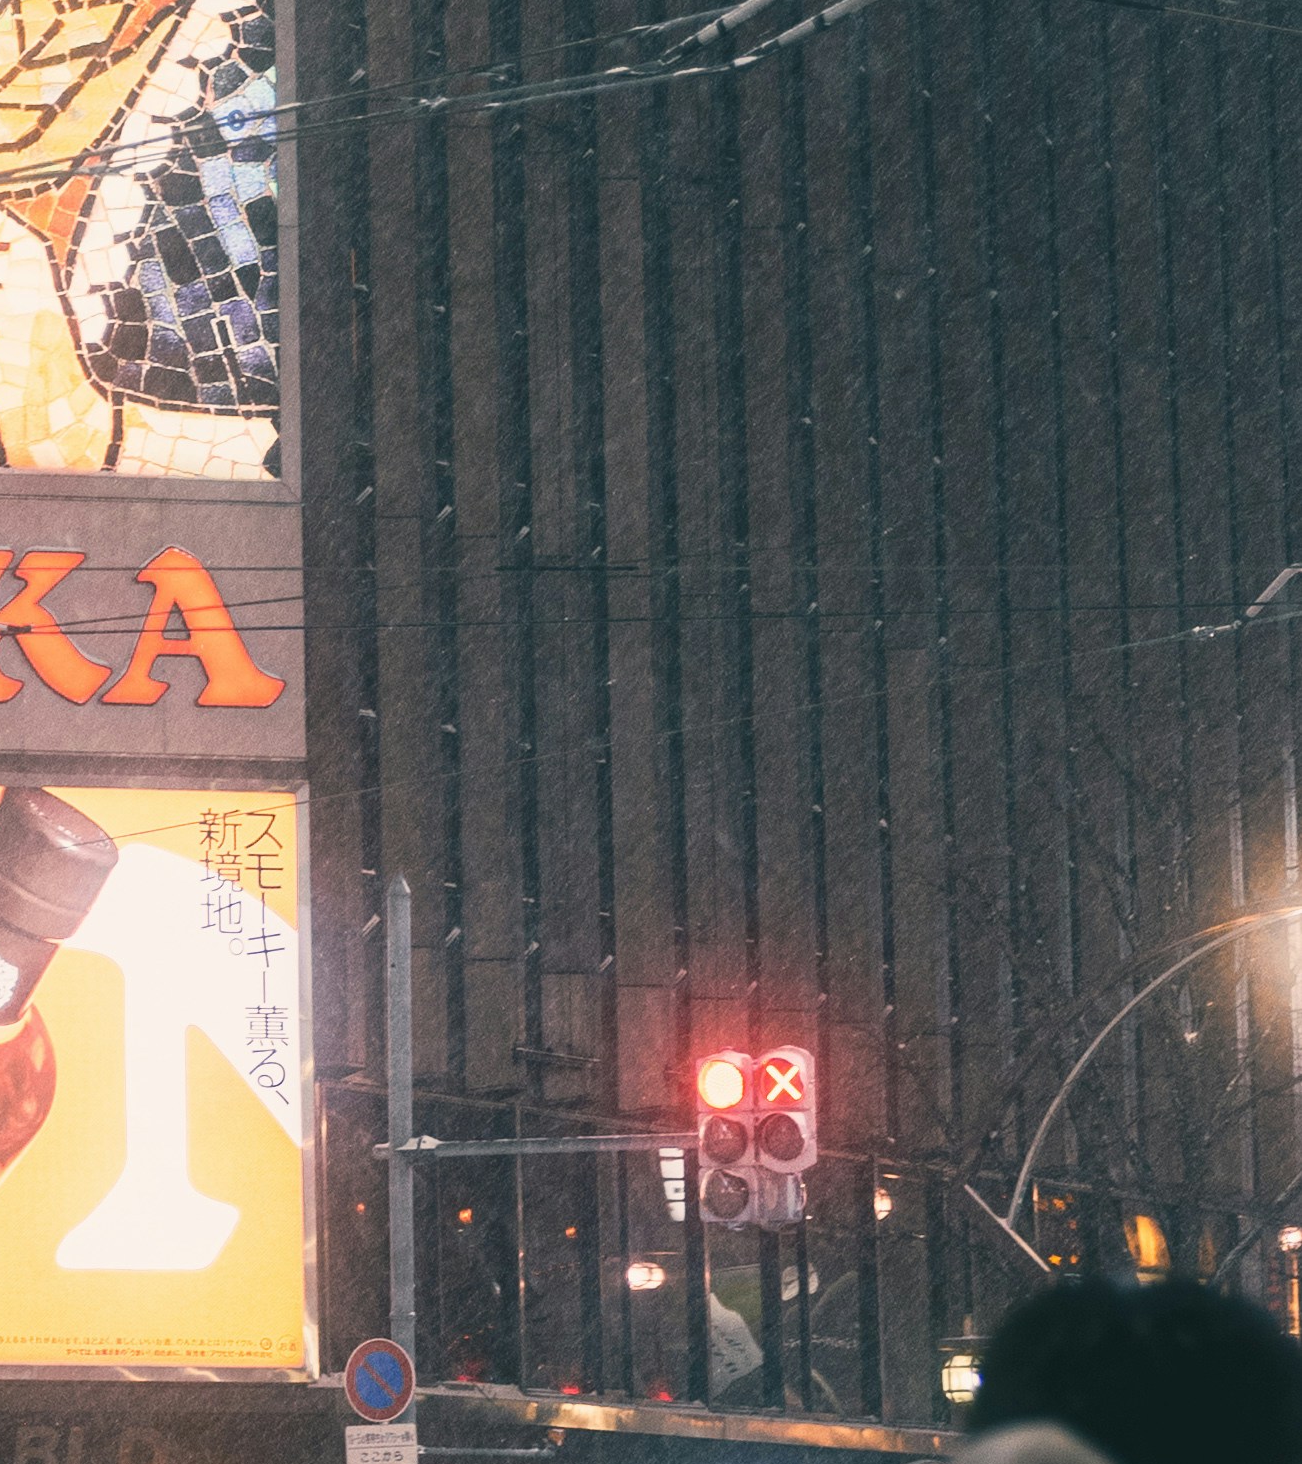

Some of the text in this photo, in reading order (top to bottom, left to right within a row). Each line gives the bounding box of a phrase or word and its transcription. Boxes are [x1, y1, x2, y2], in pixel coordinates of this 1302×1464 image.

[199, 807, 245, 957] 新境地。
[244, 811, 290, 1106] スモーキー薫る、
[360, 1450, 404, 1463] ここから
